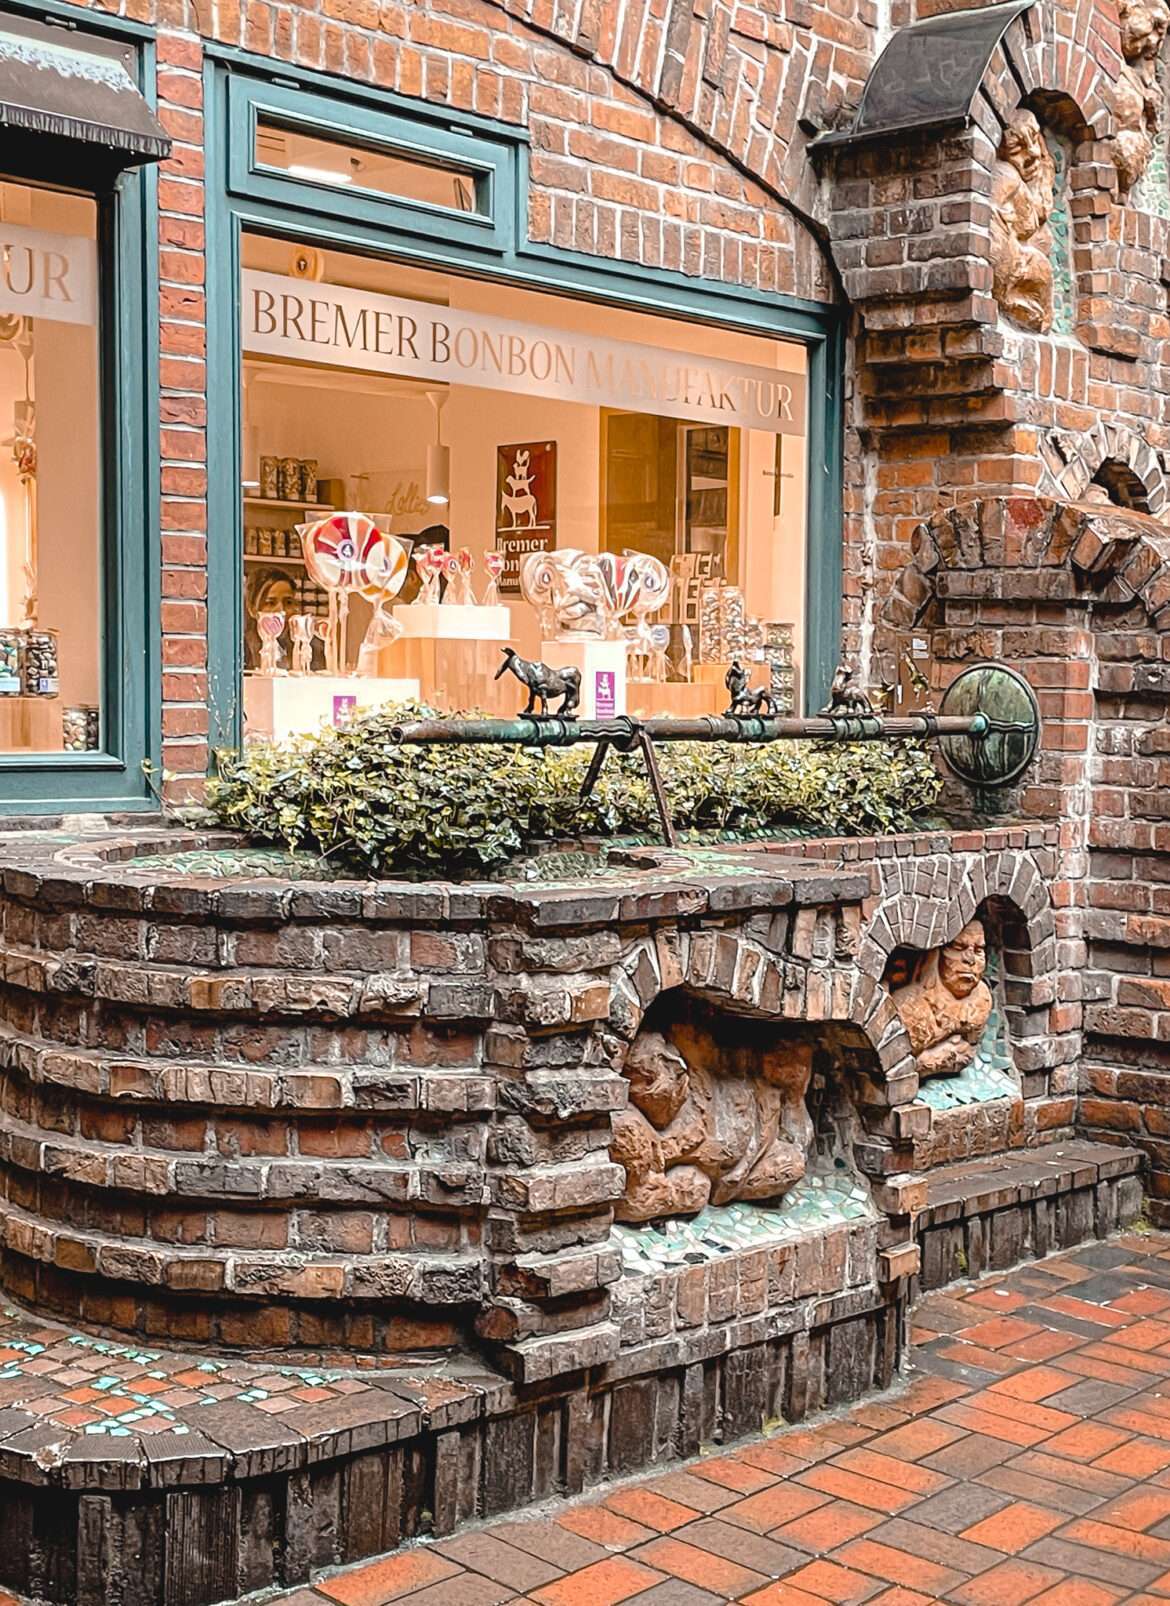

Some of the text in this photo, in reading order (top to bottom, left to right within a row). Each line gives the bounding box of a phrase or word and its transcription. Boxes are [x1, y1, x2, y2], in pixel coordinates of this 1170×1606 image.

[251, 288, 794, 422] BREMER BONBON MANUFAKTUR
